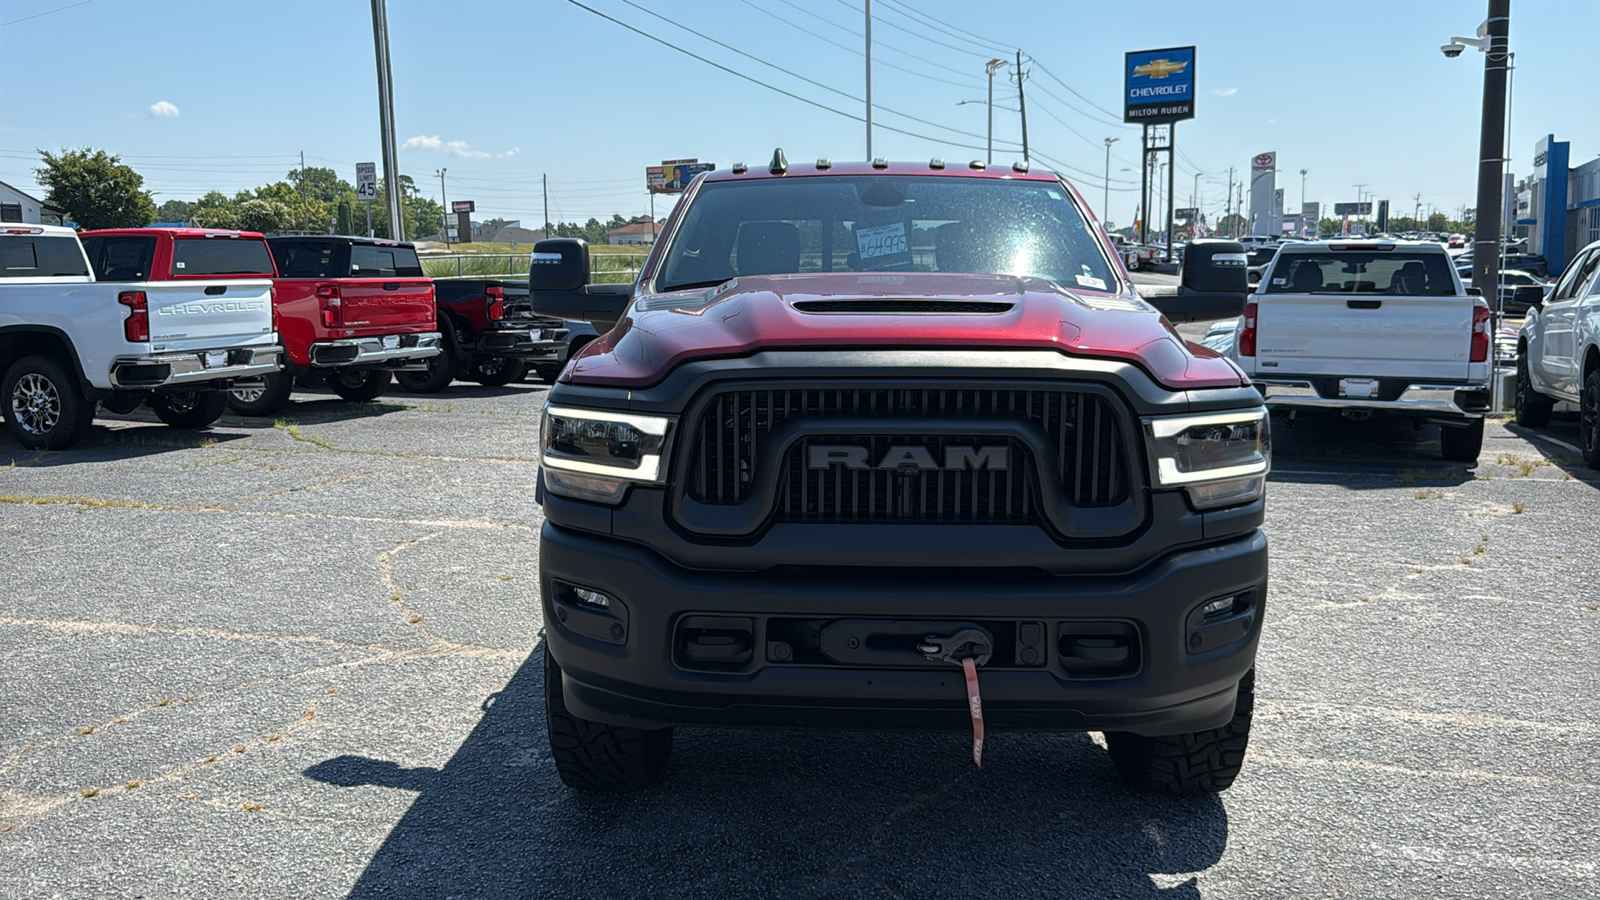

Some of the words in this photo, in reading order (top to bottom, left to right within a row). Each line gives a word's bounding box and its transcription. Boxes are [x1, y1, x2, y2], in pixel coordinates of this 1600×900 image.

[1130, 84, 1188, 98] CHEVROLET
[1128, 108, 1158, 117] MILTON
[1160, 106, 1189, 115] RUBEN
[358, 183, 375, 197] 45
[158, 301, 266, 316] CHEVROLET
[808, 445, 1009, 471] RAM
